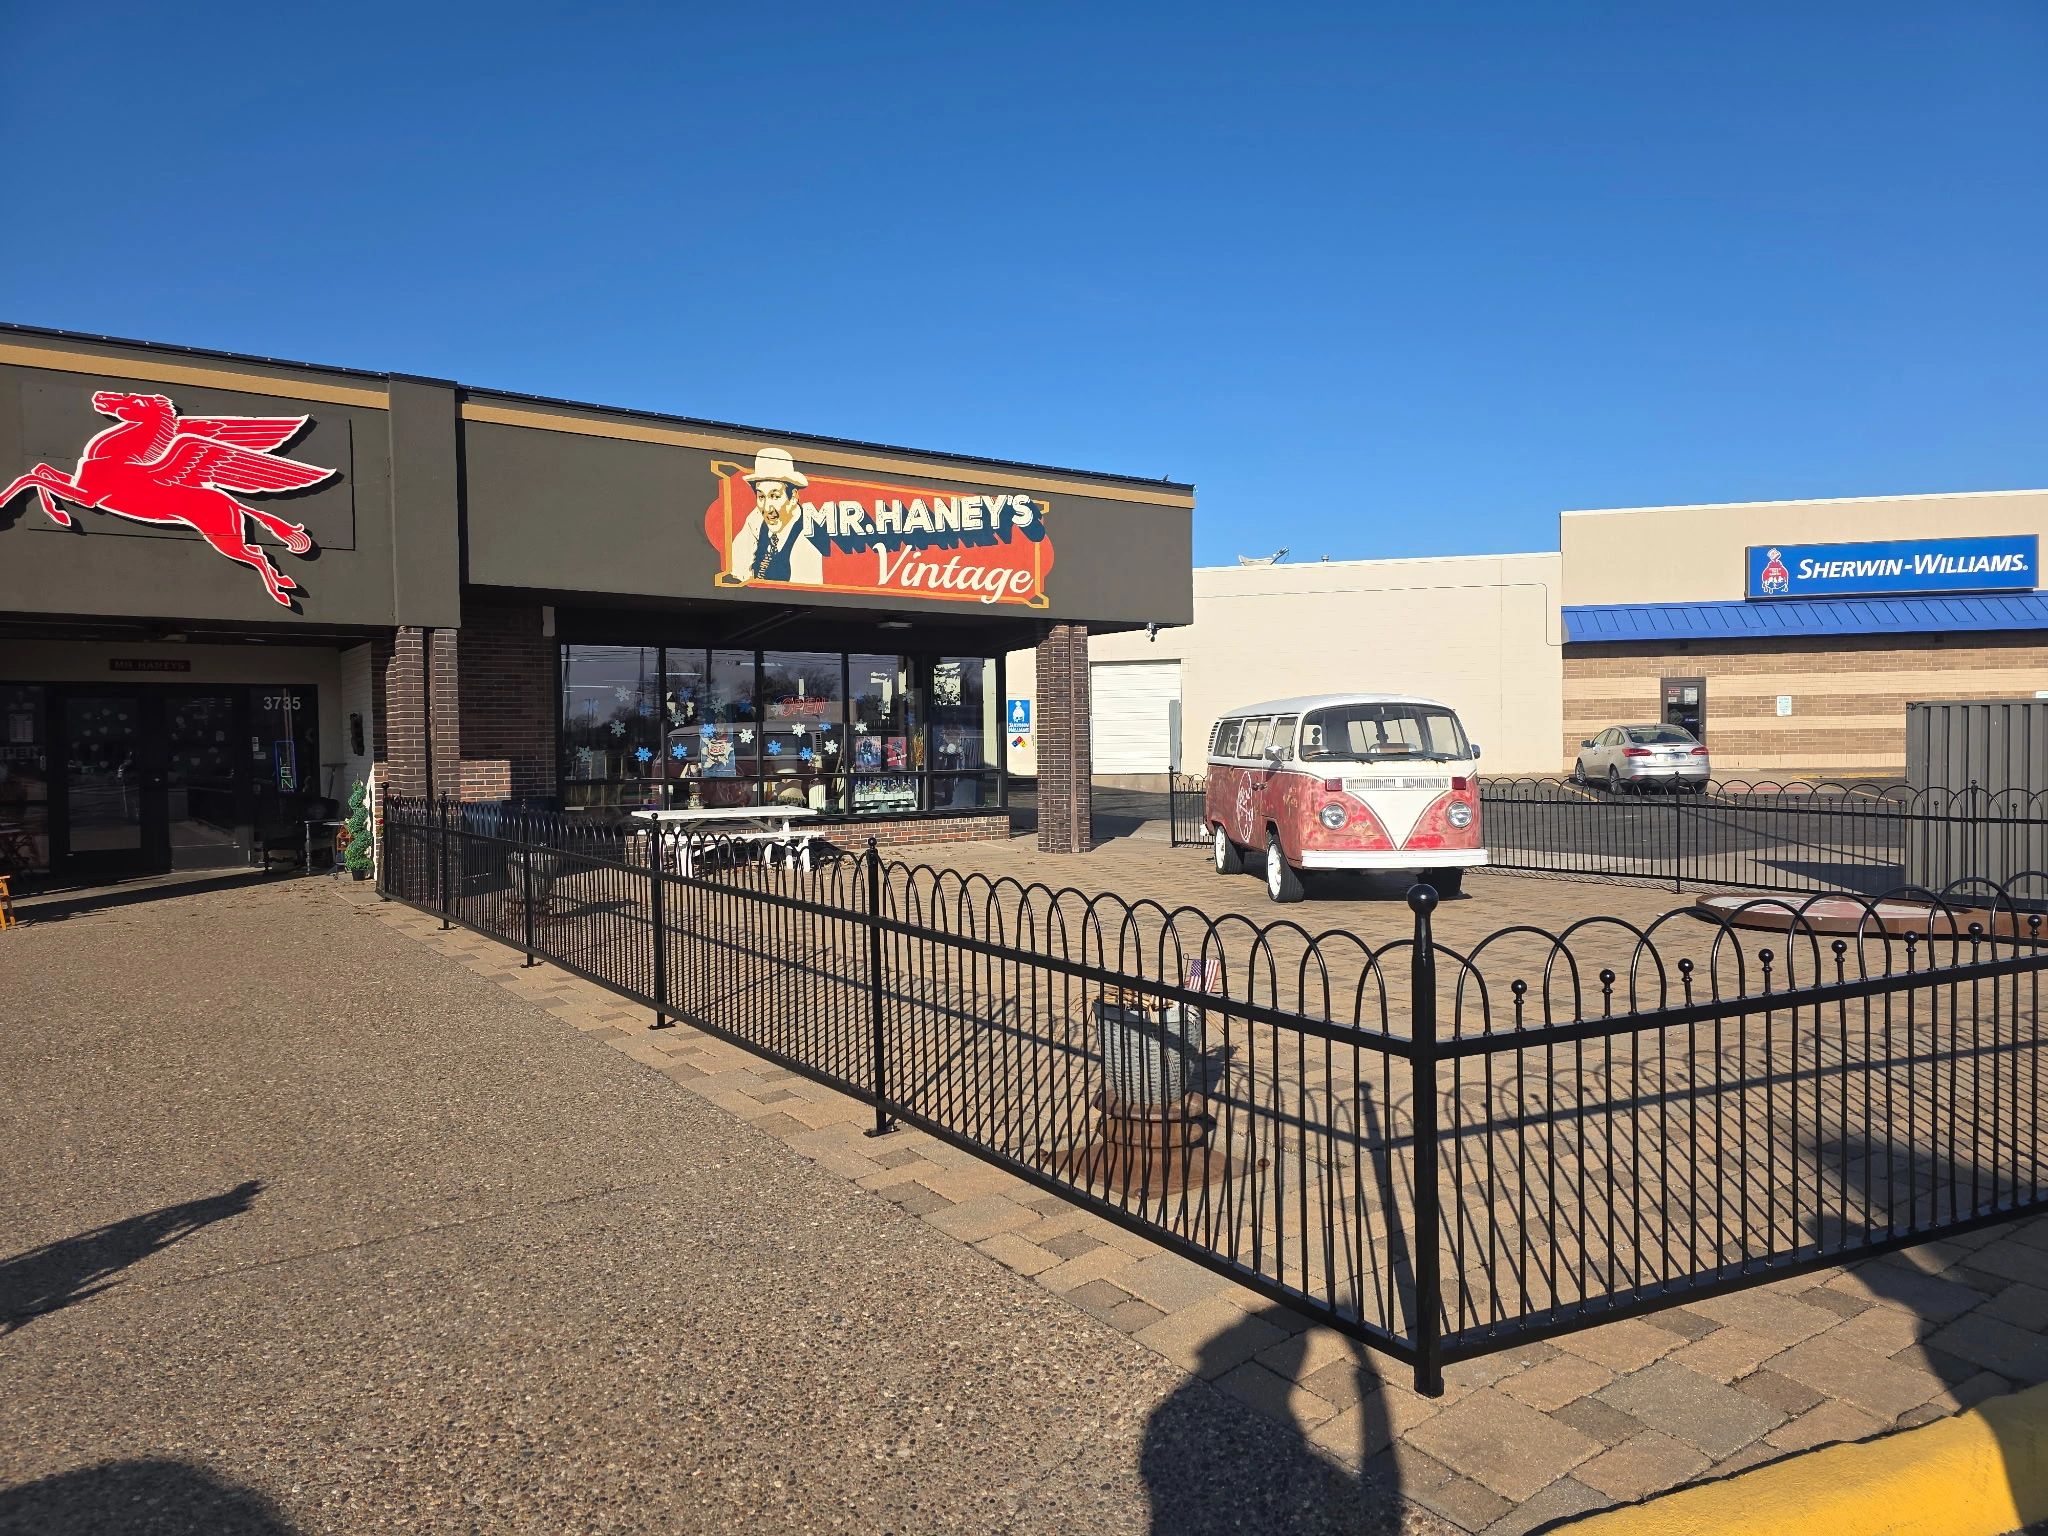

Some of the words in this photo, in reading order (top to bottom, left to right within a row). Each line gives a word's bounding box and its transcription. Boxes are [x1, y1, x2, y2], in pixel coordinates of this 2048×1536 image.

[872, 542, 1032, 604] Vintage
[262, 696, 302, 711] 3735
[781, 697, 826, 717] OPEN
